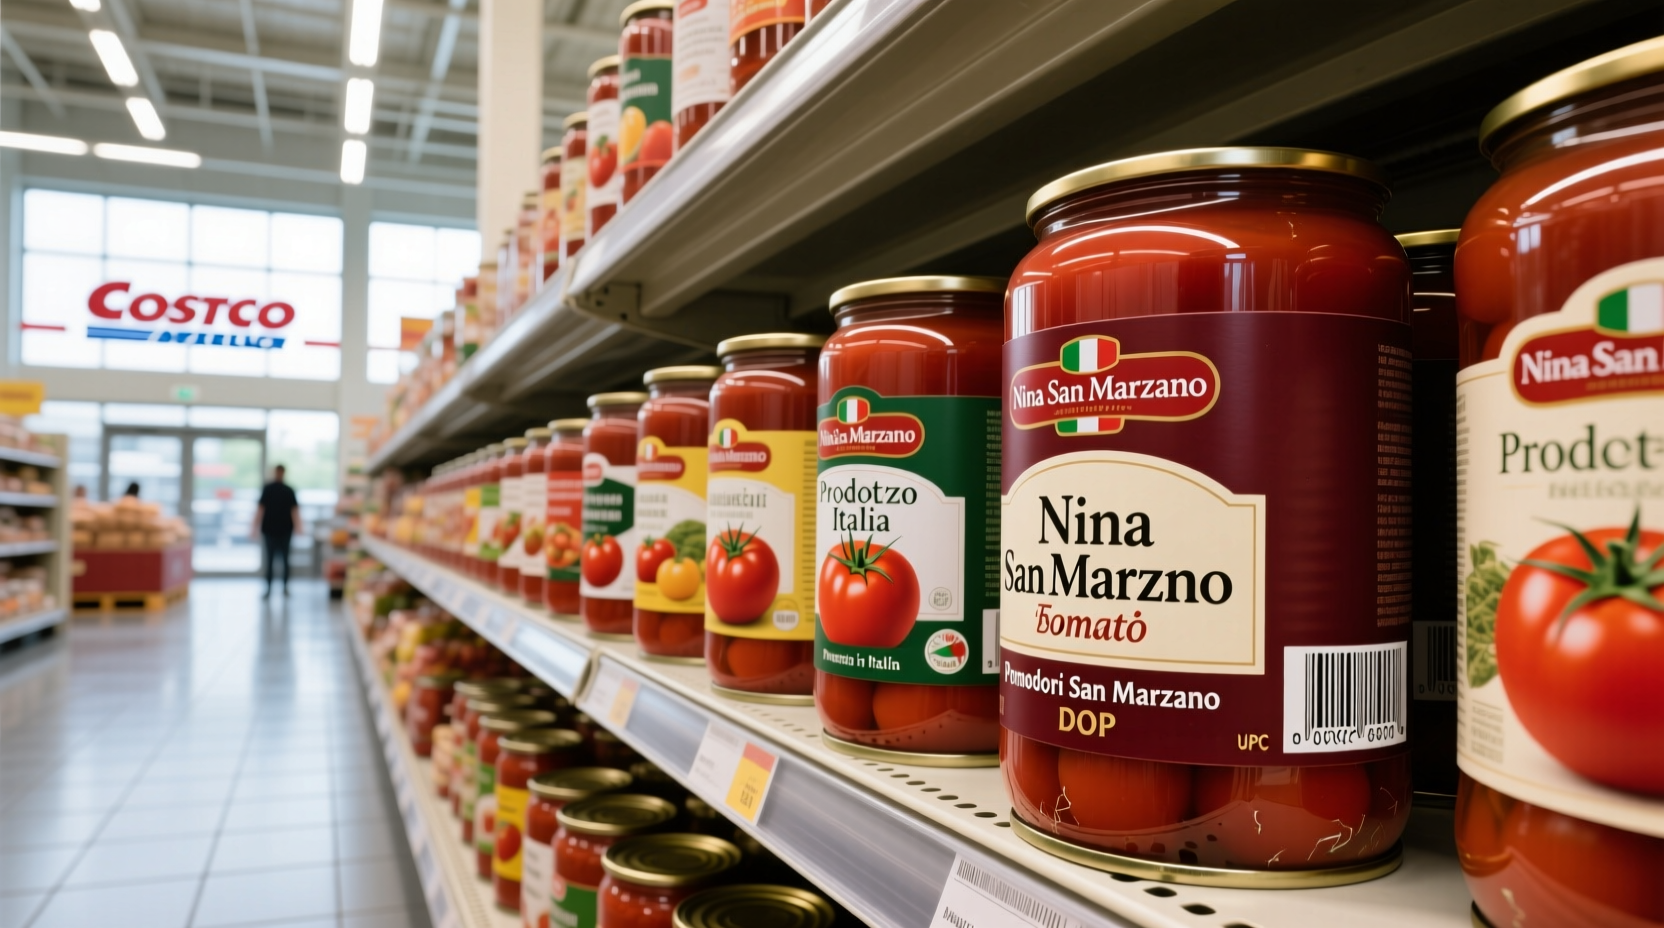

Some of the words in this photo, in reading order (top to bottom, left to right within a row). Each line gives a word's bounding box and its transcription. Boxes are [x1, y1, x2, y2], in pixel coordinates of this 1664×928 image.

[1520, 349, 1590, 385] Nina
[1592, 340, 1659, 377] San
[1013, 385, 1044, 410] Nina
[1047, 379, 1084, 406] San
[1088, 375, 1207, 402] Marzano
[849, 426, 916, 443] Marzano
[820, 478, 918, 505] Prodotzo
[832, 506, 890, 532] Italia
[1038, 495, 1155, 547] Nina
[1004, 549, 1045, 595] San
[1048, 553, 1233, 605] Marzno
[1004, 660, 1064, 696] Pomodori
[1069, 675, 1106, 703] San
[1112, 681, 1221, 711] Marzano
[1058, 706, 1116, 738] DOP
[1237, 734, 1270, 752] UPC
